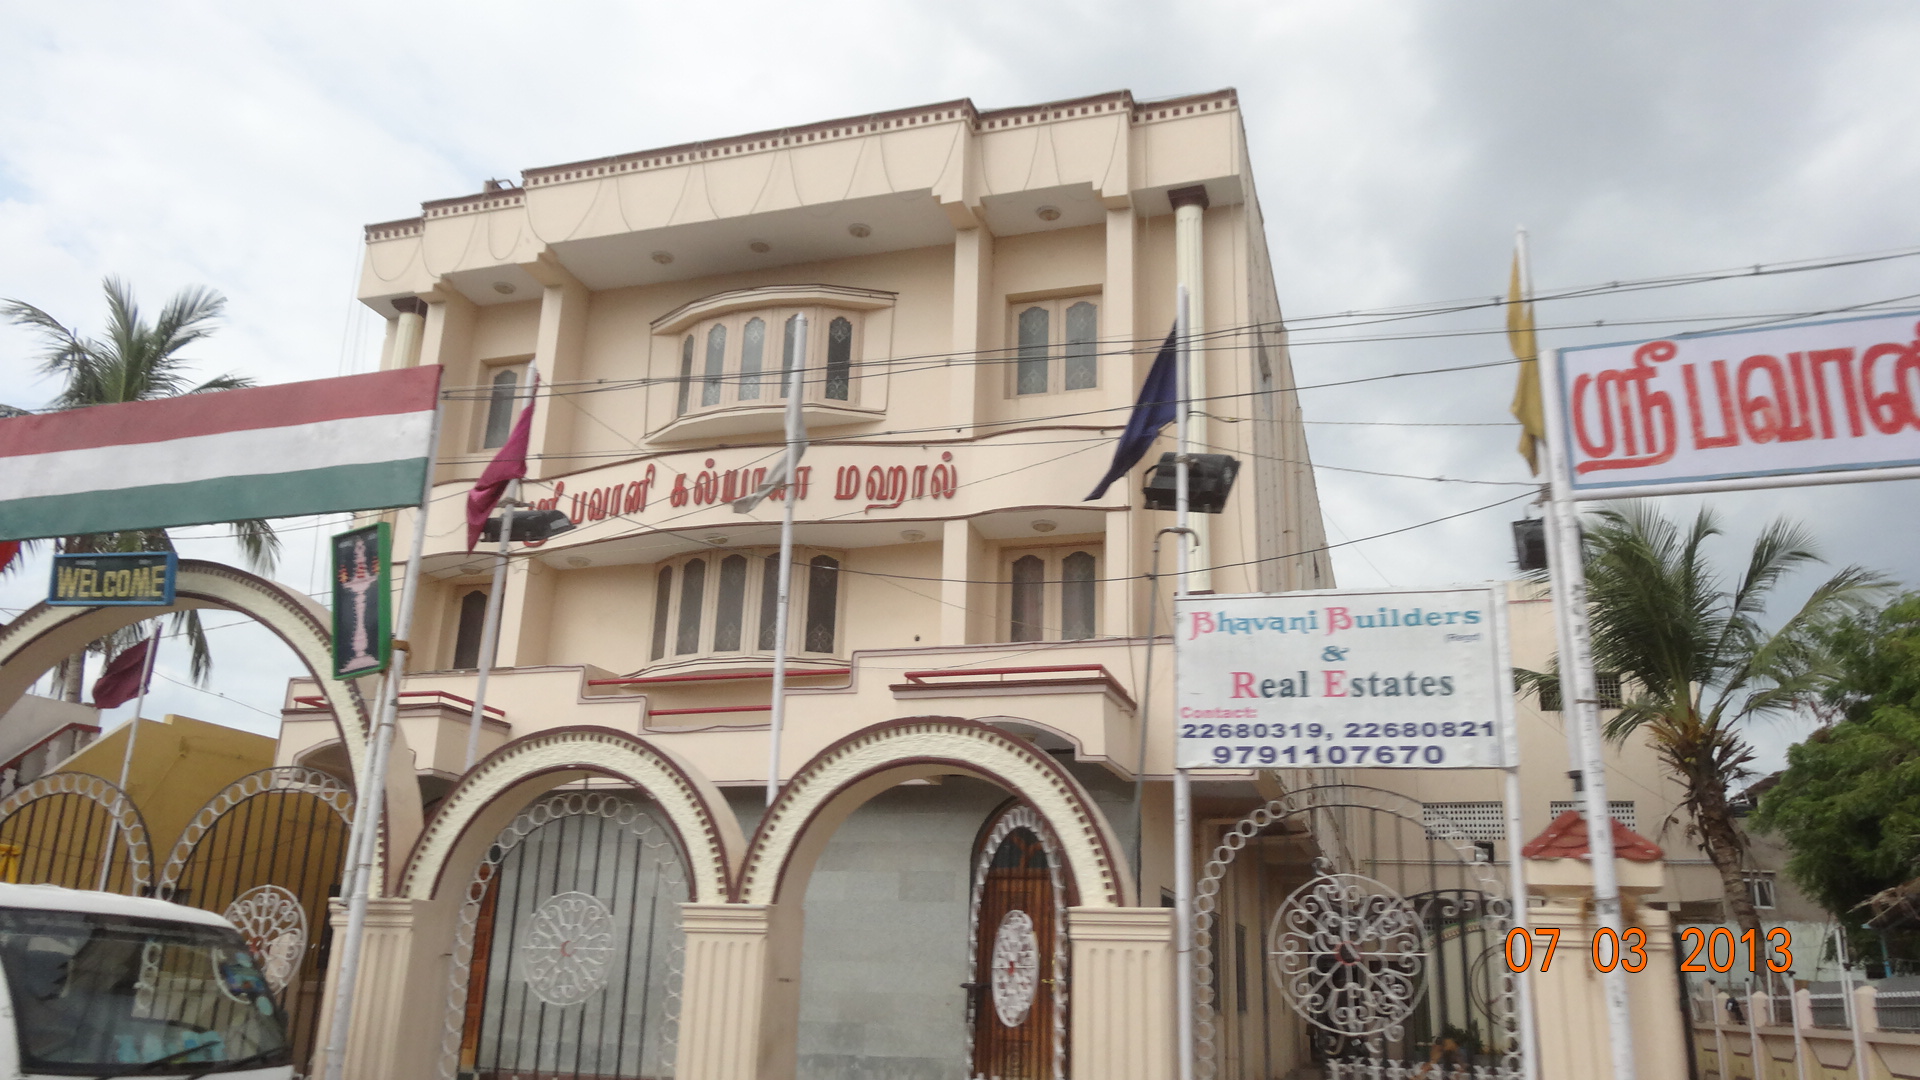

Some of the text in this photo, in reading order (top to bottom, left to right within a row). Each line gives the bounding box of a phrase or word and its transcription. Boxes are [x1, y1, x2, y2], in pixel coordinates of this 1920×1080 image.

[57, 565, 166, 598] WELCOME
[1189, 606, 1482, 641] Bhavani Builders
[1321, 645, 1349, 663] &
[1231, 670, 1456, 699] Real Estates
[1180, 706, 1258, 719] Contact:
[1181, 721, 1495, 741] 22680319, 22680821
[1213, 745, 1446, 765] 9791107670
